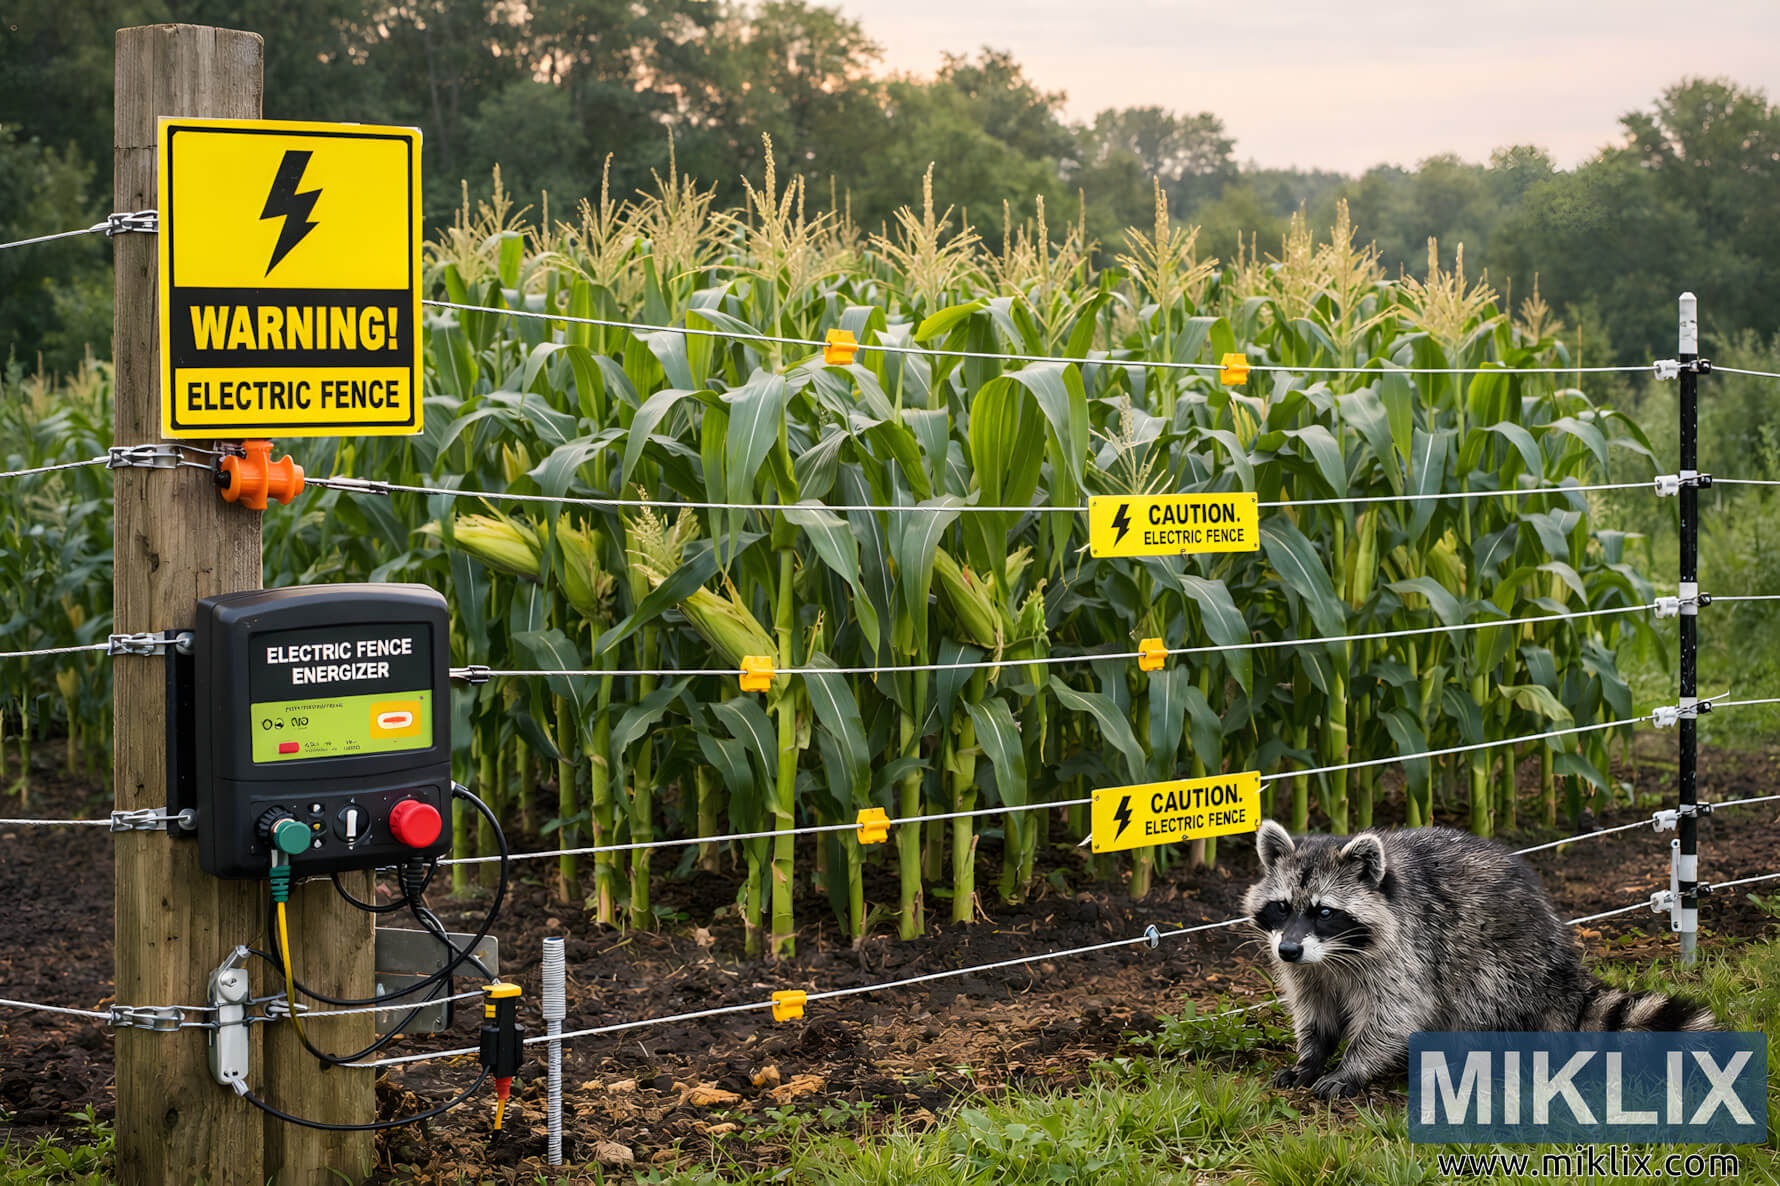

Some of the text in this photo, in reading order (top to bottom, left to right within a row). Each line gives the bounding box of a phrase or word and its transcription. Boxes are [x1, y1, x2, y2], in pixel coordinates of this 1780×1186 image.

[190, 305, 399, 351] WARNING!
[188, 380, 400, 411] ELECTRIC FENCE
[1149, 503, 1241, 525] CAUTION.
[1144, 528, 1244, 545] ELECTRIC FENCE
[266, 638, 412, 664] ELECTRIC FENCE
[292, 661, 389, 685] ENERGIZER
[1151, 783, 1243, 814] CAUTION.
[1145, 808, 1246, 836] ELECTRIC FENCE
